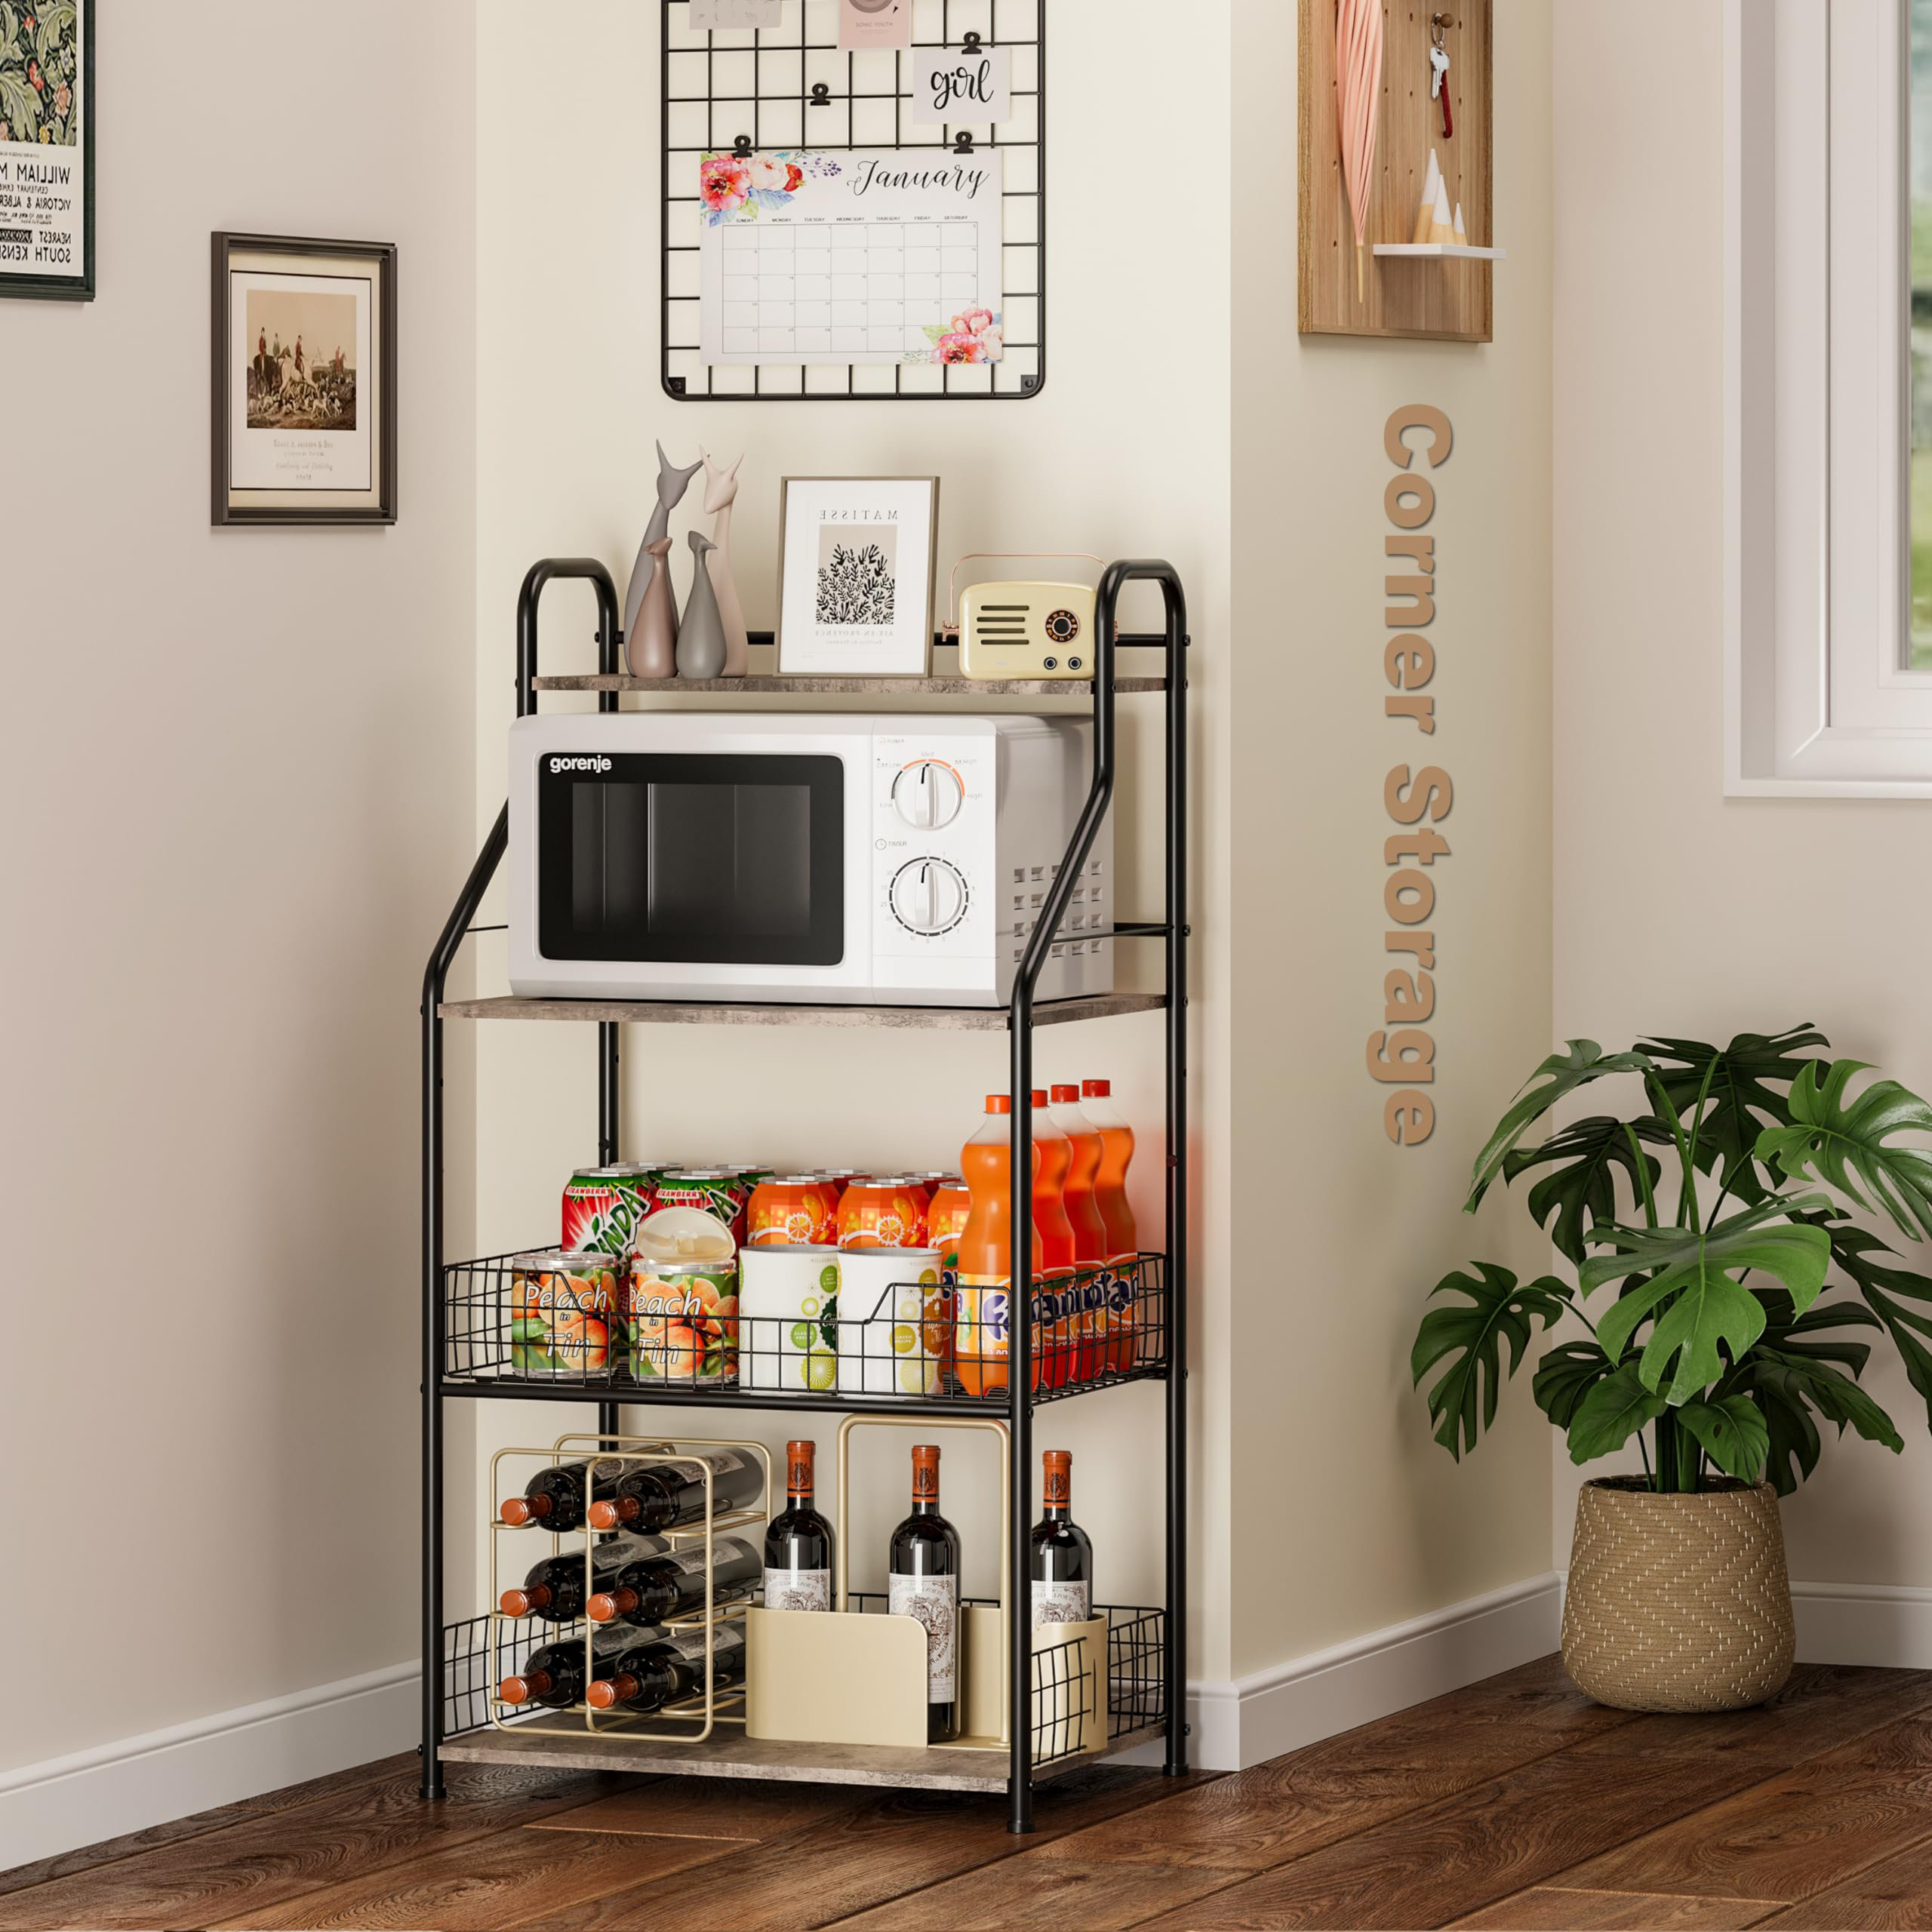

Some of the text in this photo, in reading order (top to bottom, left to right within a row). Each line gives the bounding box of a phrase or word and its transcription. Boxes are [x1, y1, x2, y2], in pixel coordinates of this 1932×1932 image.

[931, 59, 994, 109] girl
[846, 160, 990, 199] January
[549, 755, 612, 774] gorenje
[566, 1187, 611, 1195] STRAWBERRY
[657, 1189, 702, 1198] STRAWBERRY
[526, 1284, 608, 1309] Peach
[559, 1312, 571, 1321] in
[649, 1318, 659, 1327] in
[543, 1333, 591, 1358] Tin
[638, 1337, 680, 1364] Tin
